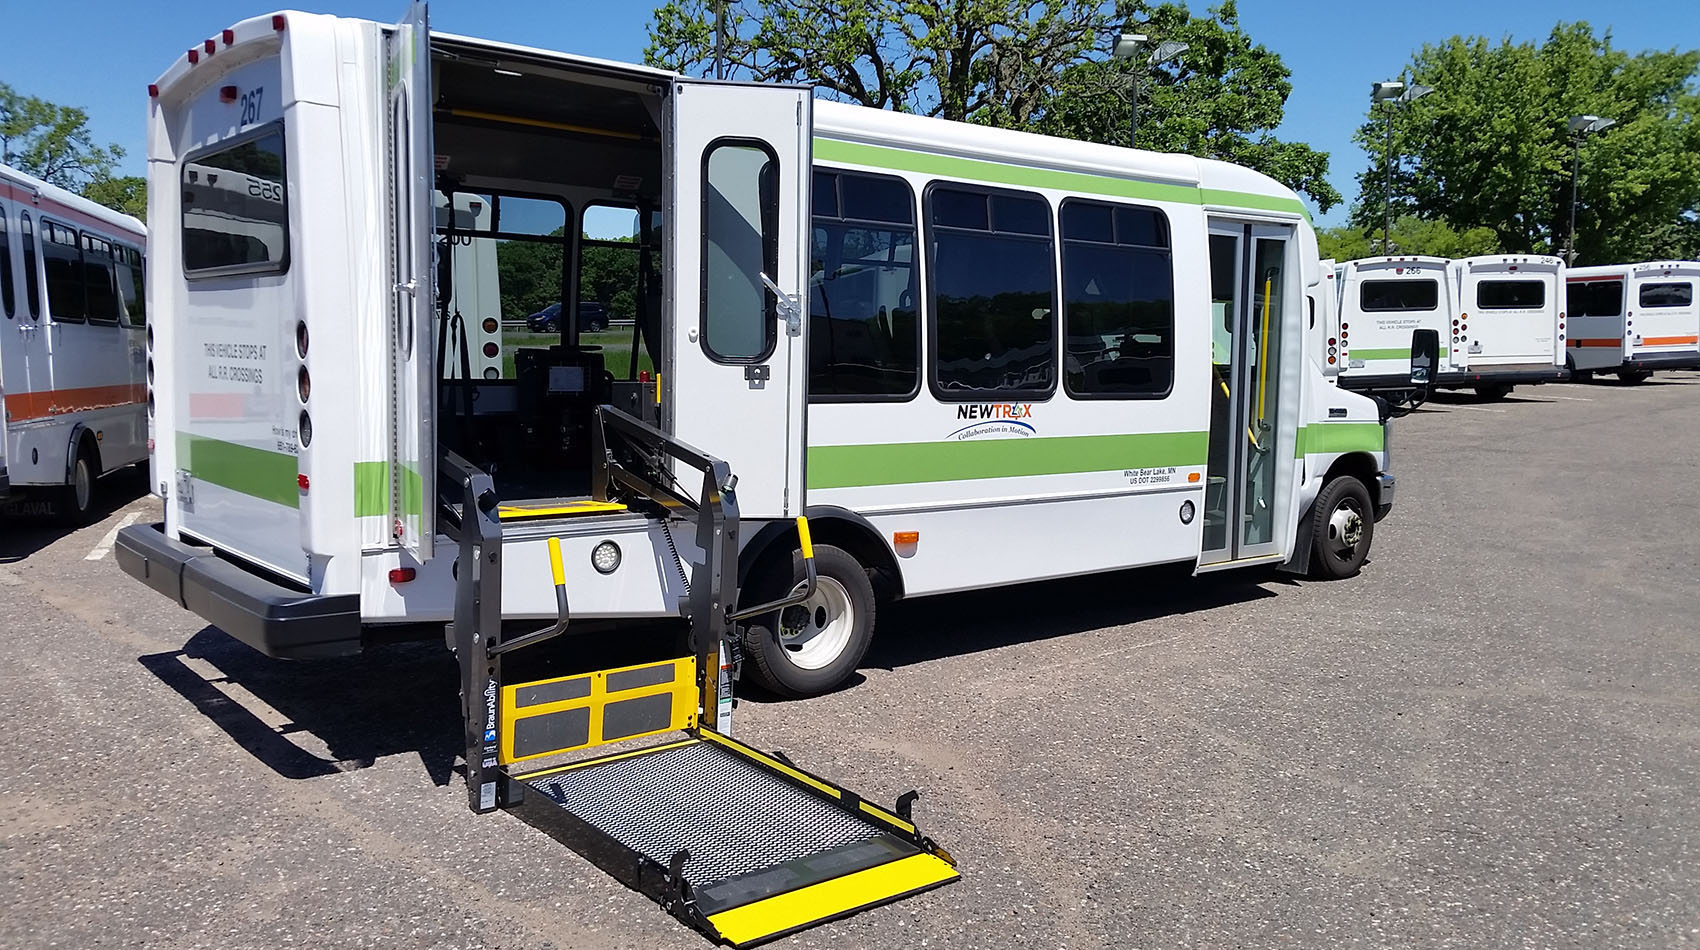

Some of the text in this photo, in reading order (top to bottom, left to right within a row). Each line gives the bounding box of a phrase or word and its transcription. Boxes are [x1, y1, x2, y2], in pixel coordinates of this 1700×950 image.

[240, 87, 264, 127] 267
[204, 343, 267, 361] THIS VEHICLE STOPS AT
[208, 364, 218, 379] ALL
[230, 366, 263, 384] CROSSINGS
[957, 402, 1032, 420] NEWTRAX
[958, 425, 1030, 440] Collaboration in Motion
[1129, 477, 1138, 485] US
[1140, 468, 1152, 476] Bear
[484, 679, 498, 730] BraunAbility
